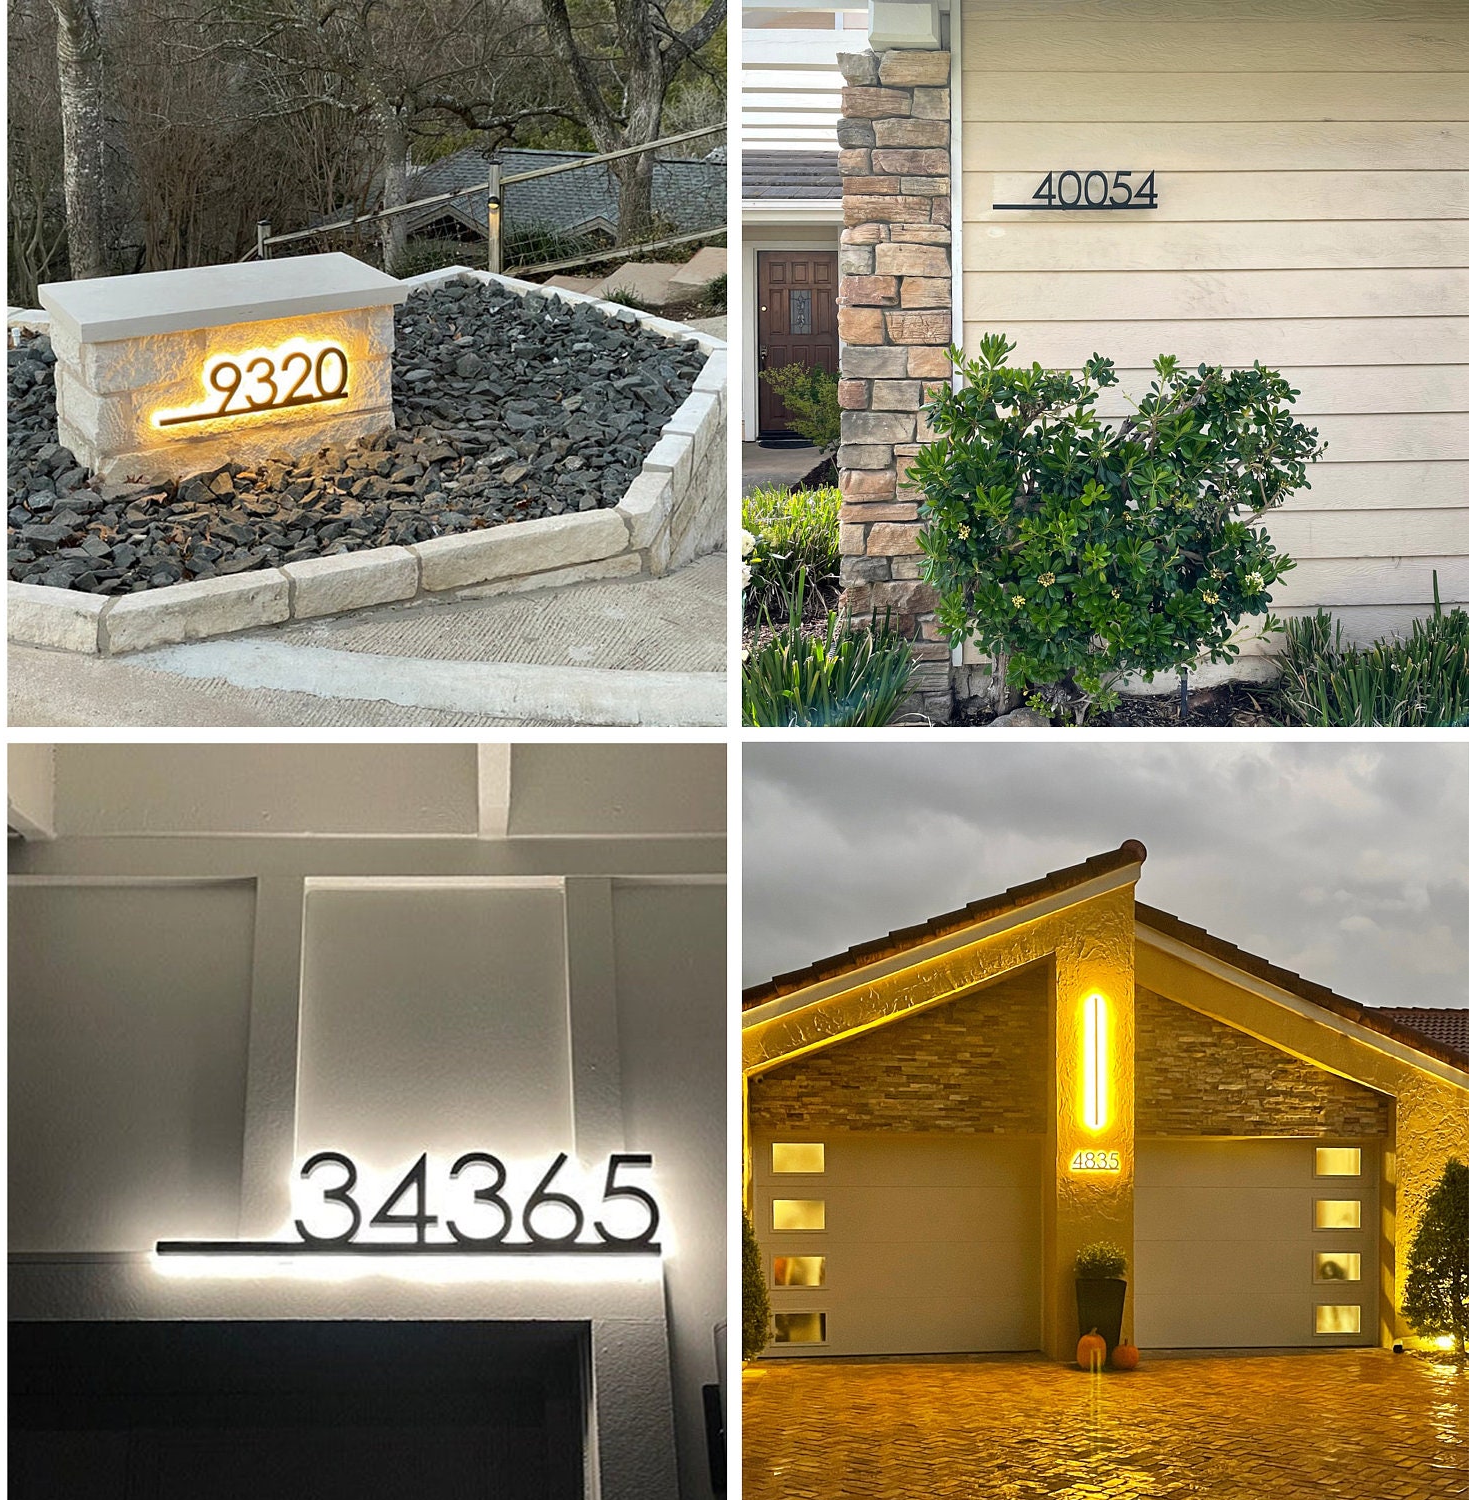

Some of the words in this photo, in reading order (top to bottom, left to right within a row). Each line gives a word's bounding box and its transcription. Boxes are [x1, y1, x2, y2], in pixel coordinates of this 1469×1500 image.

[1032, 170, 1158, 208] 40054
[211, 347, 348, 414] 9320
[1072, 1152, 1119, 1169] 4835
[294, 1152, 661, 1248] 34365
